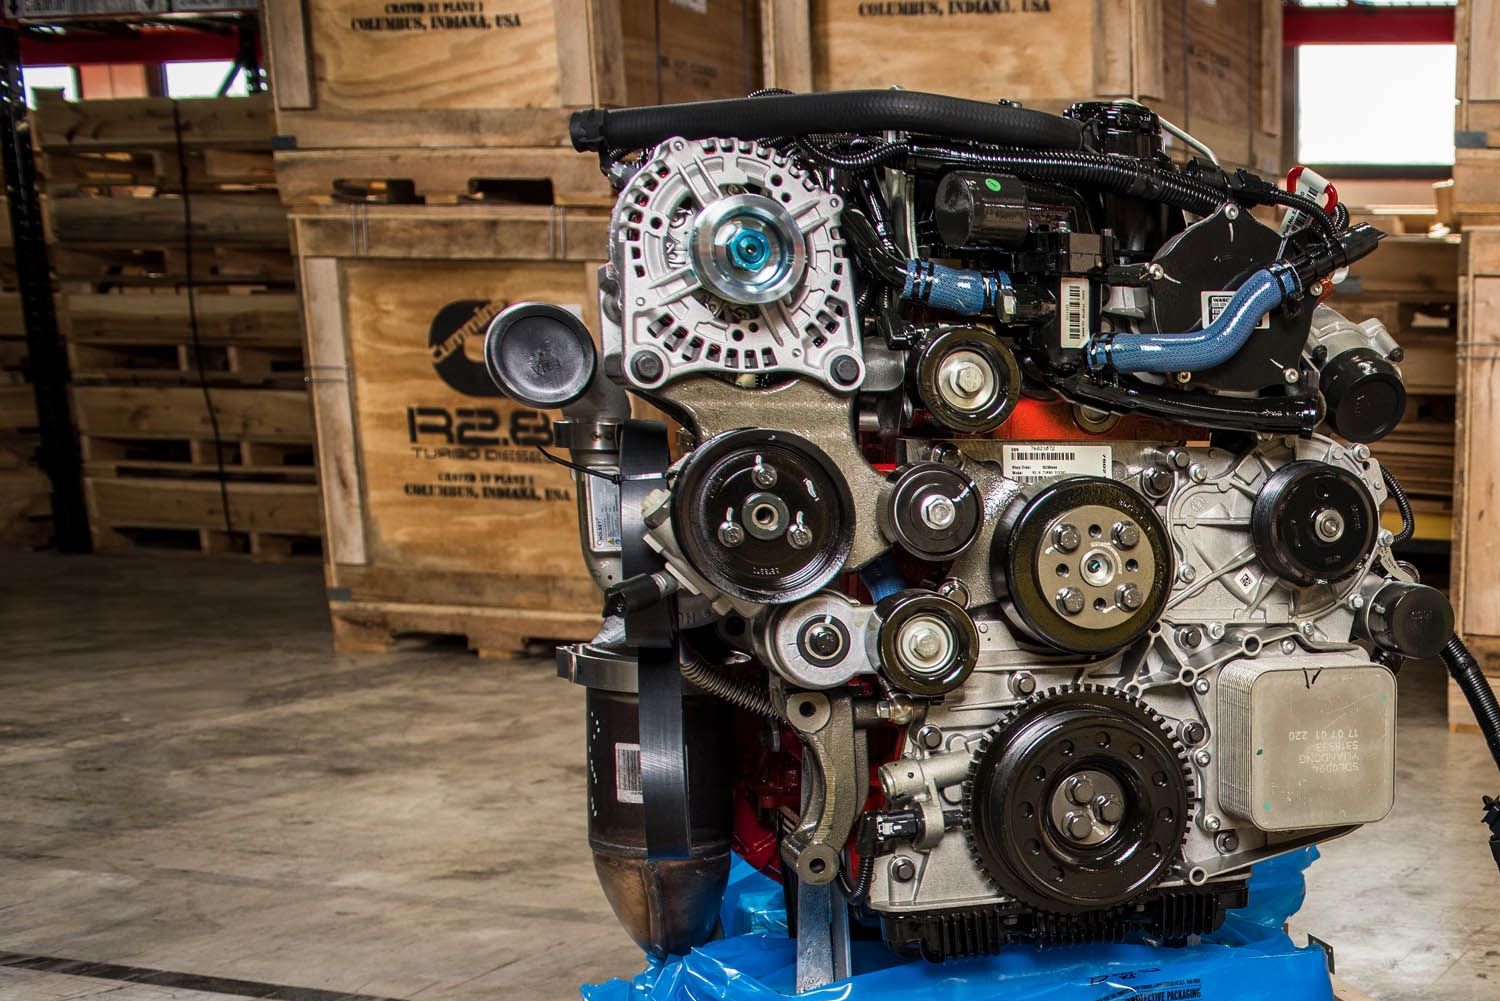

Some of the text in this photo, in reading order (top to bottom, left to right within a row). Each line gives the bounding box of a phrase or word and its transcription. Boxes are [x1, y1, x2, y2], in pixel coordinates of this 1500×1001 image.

[1021, 0, 1051, 13] USA
[495, 13, 522, 28] USA
[406, 407, 554, 446] R2.8
[411, 446, 482, 461] TURBO
[544, 487, 571, 502] USA
[1166, 987, 1201, 1001] PACKAGING
